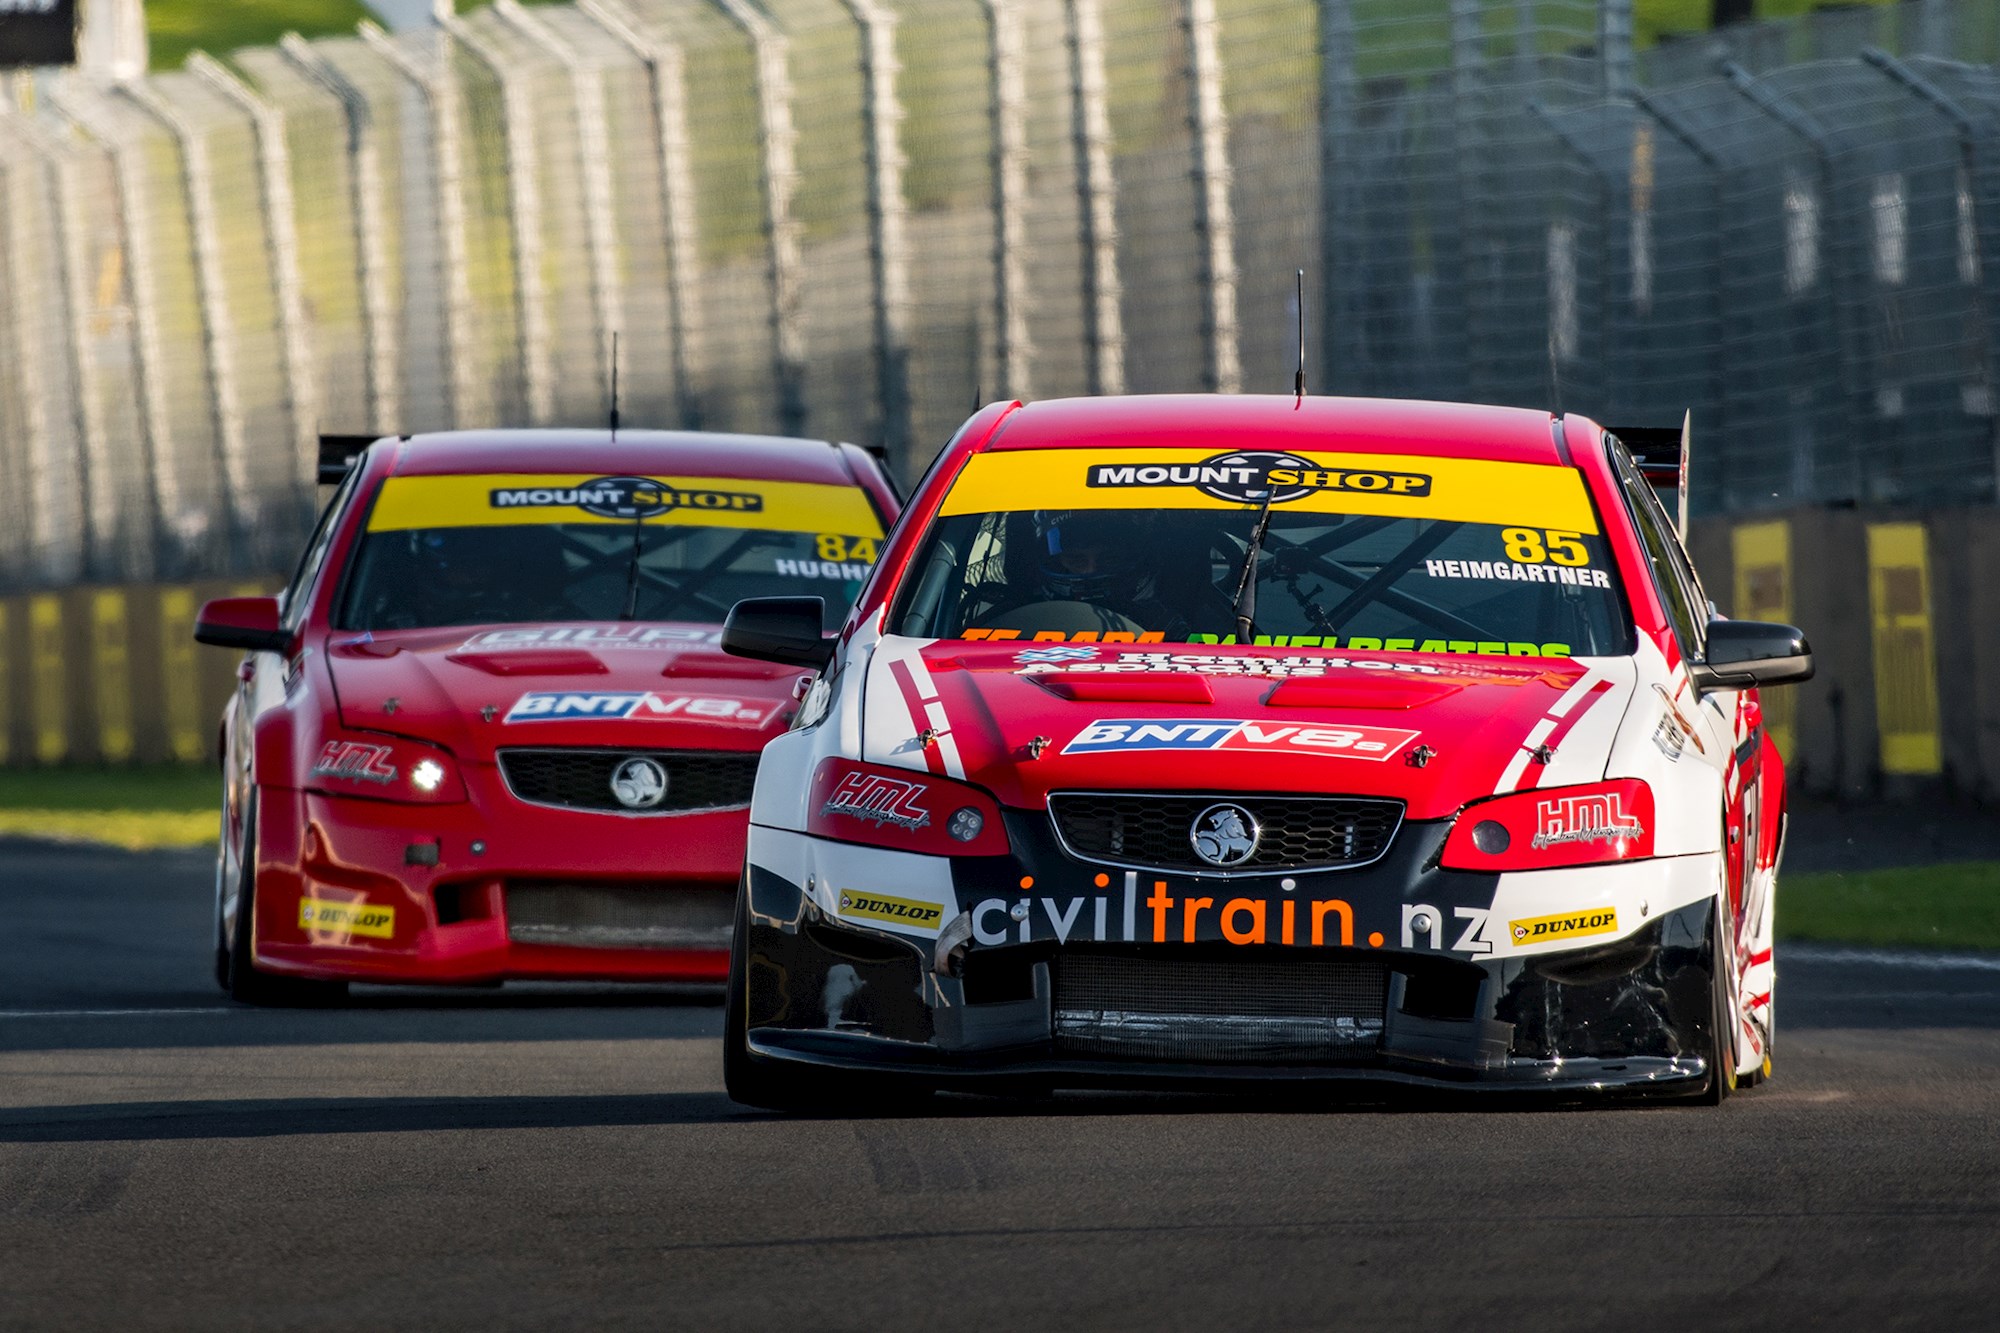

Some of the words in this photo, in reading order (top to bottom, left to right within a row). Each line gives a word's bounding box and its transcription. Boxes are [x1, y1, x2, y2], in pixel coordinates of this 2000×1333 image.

[1098, 467, 1259, 484] MOUNT
[1267, 469, 1425, 493] SHOP
[499, 489, 625, 505] MOUNT
[631, 490, 759, 509] SHOP
[815, 533, 876, 565] 84
[1501, 527, 1590, 567] 85
[1426, 559, 1611, 589] HEIMGARTNER
[1012, 662, 1326, 677] Asphalts
[1117, 653, 1440, 674] Hamilton
[826, 771, 929, 821] HML
[1536, 792, 1638, 838] HML
[319, 909, 390, 928] DUNLOP
[853, 898, 940, 921] DUNLOP
[971, 872, 1492, 953] civiltrain.nz
[1532, 913, 1615, 936] DUNLOP
